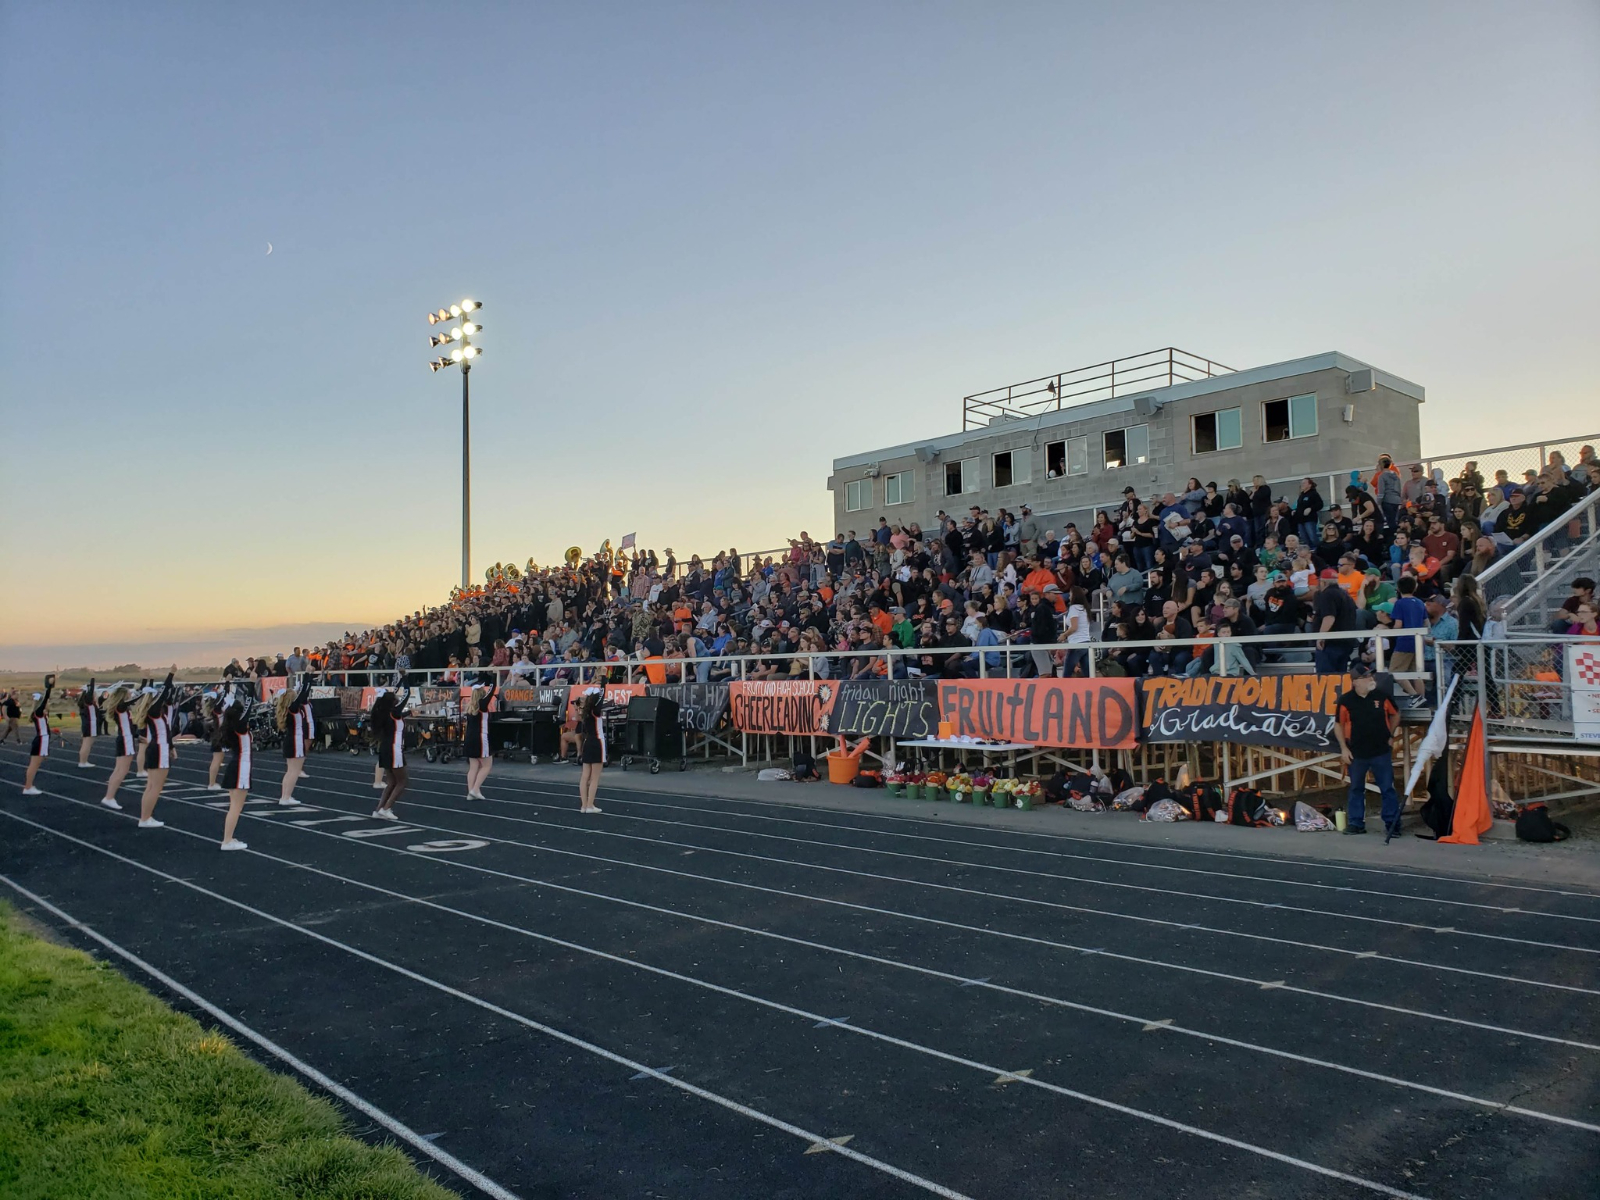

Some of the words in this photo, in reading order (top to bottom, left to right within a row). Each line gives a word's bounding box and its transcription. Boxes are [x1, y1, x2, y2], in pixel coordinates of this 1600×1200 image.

[504, 689, 534, 701] ORANGE
[743, 681, 776, 695] FRUITLAND
[777, 681, 792, 695] HIGH
[793, 680, 818, 695] SCHOOL
[841, 684, 879, 701] friday
[888, 684, 925, 706] night
[1142, 676, 1277, 728] TRADITION
[838, 700, 933, 738] LIGHTS
